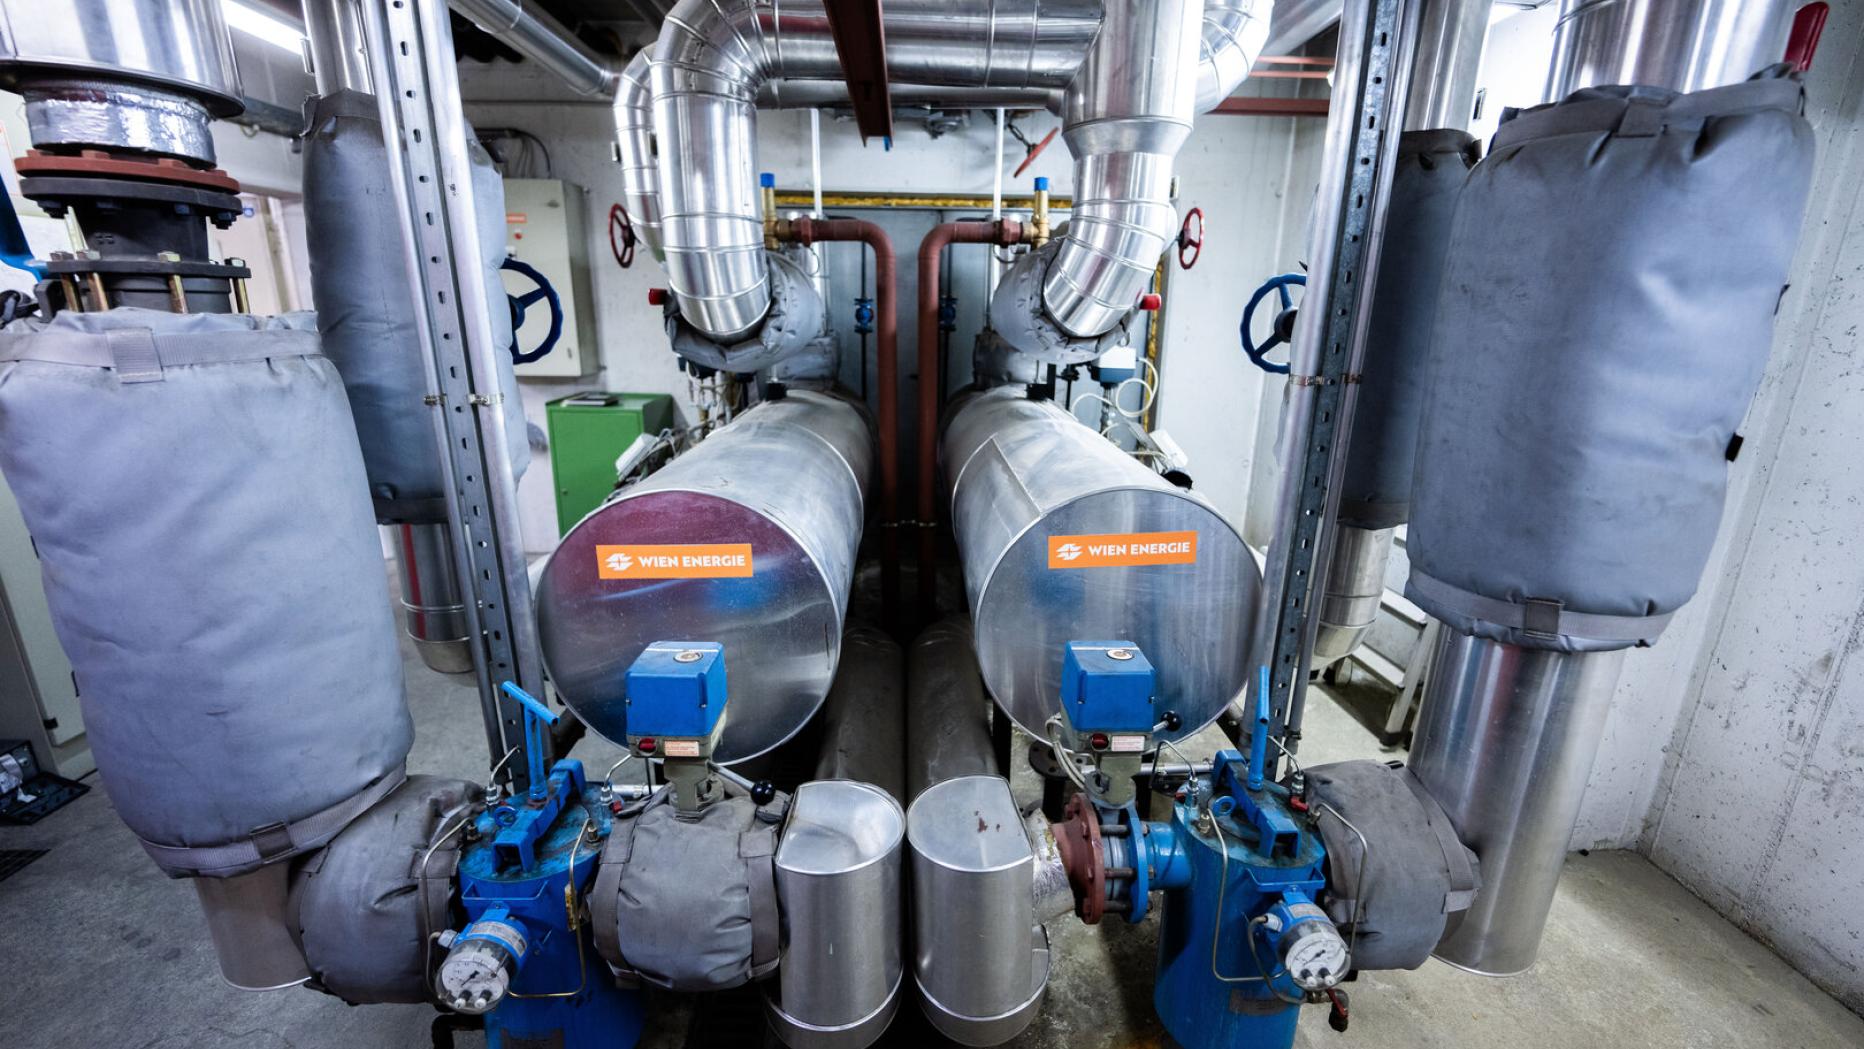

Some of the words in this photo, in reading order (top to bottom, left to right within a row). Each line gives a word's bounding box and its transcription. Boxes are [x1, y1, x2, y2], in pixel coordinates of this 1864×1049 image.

[1088, 544, 1127, 556] WIEN
[1130, 542, 1191, 555] ENERGIE
[638, 556, 679, 568] WIEN
[682, 555, 746, 567] ENERGIE
